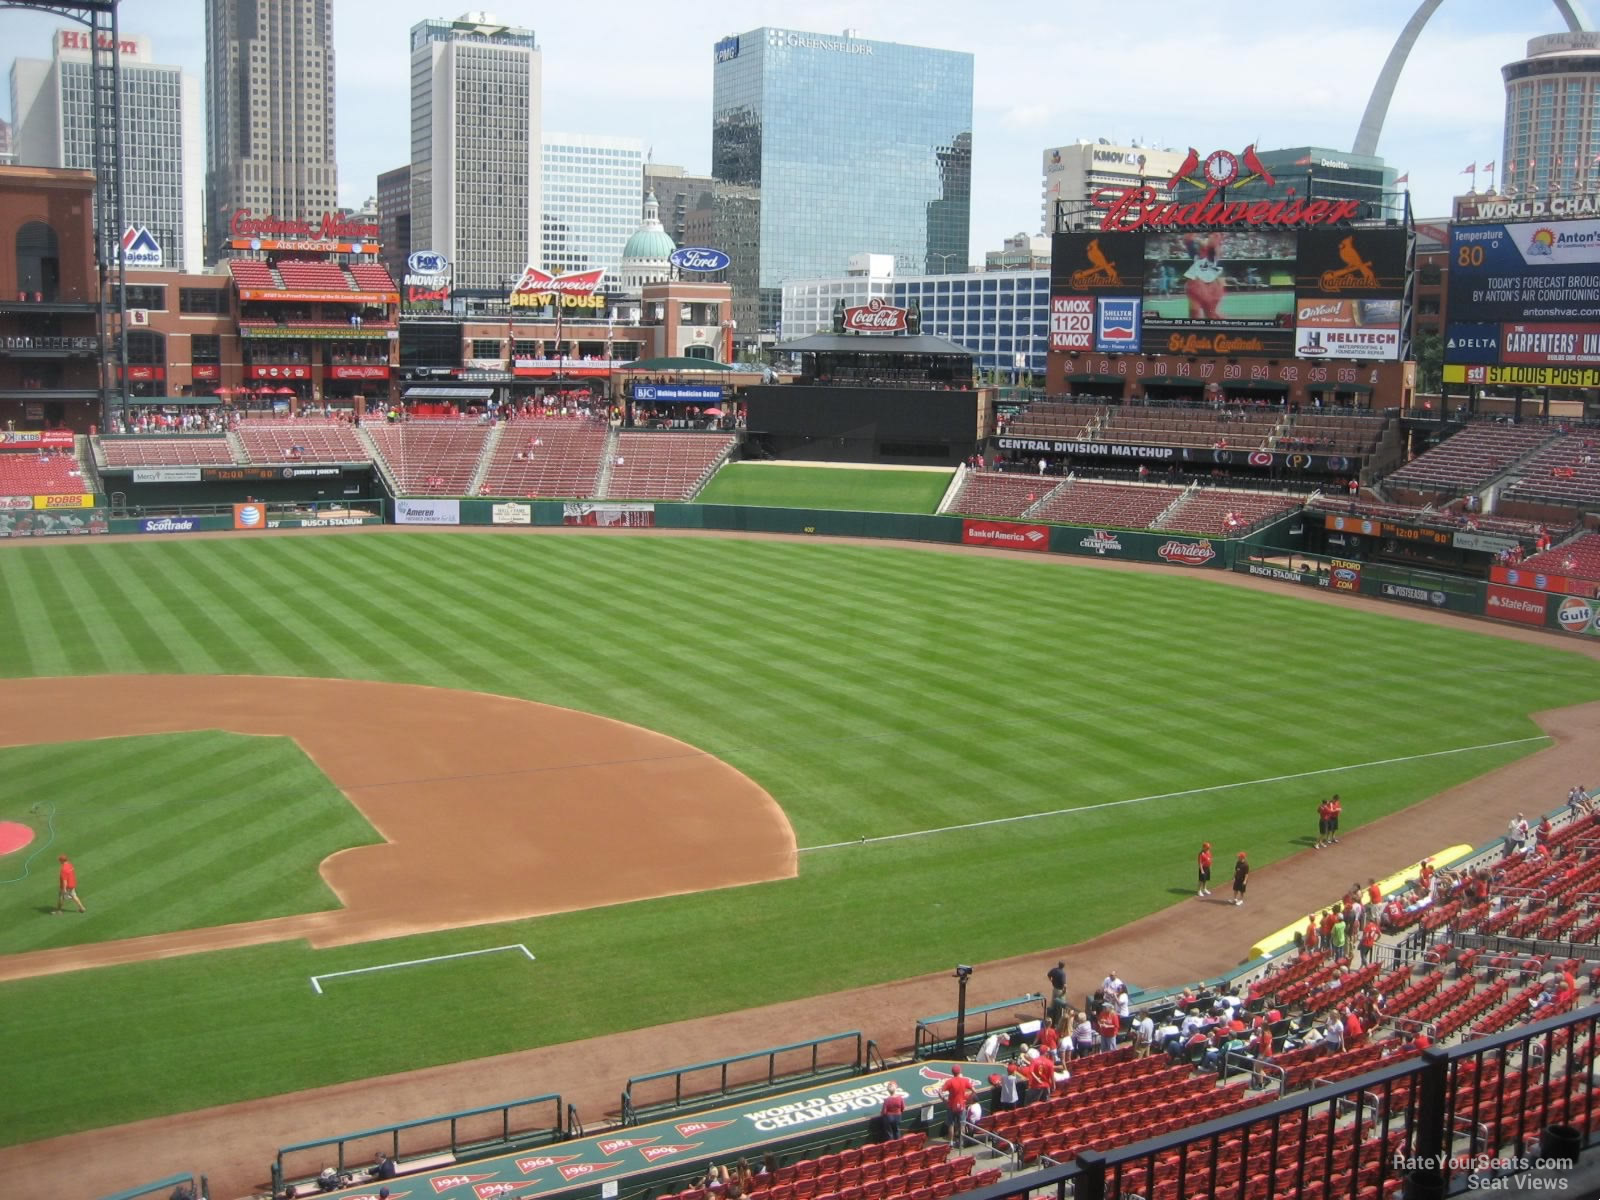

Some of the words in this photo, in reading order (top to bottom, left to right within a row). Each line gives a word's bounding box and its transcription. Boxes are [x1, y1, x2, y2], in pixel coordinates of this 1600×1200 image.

[62, 30, 137, 54] Hiton
[716, 46, 735, 62] KPMG
[1093, 149, 1124, 163] KMOV
[1091, 186, 1358, 232] Budweiser
[1476, 201, 1545, 218] WORLD
[231, 208, 310, 238] Cardinals
[310, 211, 380, 240] Nation
[1455, 230, 1503, 243] Temperature
[1557, 231, 1600, 244] Anton's
[276, 241, 296, 250] AT&T
[297, 241, 338, 251] ROOFTOP
[122, 251, 160, 264] ajestic
[417, 255, 439, 265] FOX
[682, 251, 719, 268] Ford
[1458, 245, 1485, 267] 80
[404, 274, 451, 286] MIDWEST
[510, 274, 607, 290] Budweiser
[1488, 277, 1520, 289] TODAY'S
[1523, 276, 1566, 288] FORECAST
[1568, 275, 1600, 288] BROUG
[510, 293, 552, 307] BREW
[555, 294, 605, 308] HOUSE
[1473, 290, 1483, 302] BY
[1485, 290, 1520, 301] ANTON'S
[1522, 290, 1535, 301] AIR
[1538, 289, 1599, 301] CONDITIONING
[1055, 300, 1090, 312] KMOX
[1523, 307, 1600, 316] antonshvac.com
[1055, 316, 1090, 331] 1120
[1053, 334, 1089, 347] KMOX
[1327, 332, 1396, 344] HELITECH
[1459, 338, 1496, 348] DELTA
[1507, 333, 1578, 354] CARPENTERS'
[1086, 360, 1091, 374] 1
[1100, 361, 1109, 374] 2
[1118, 361, 1127, 374] 6
[1136, 362, 1145, 375] 9
[1154, 362, 1167, 376] 10
[1177, 362, 1190, 376] 14
[1200, 363, 1214, 378] 17
[1224, 364, 1241, 379] 20
[1251, 365, 1269, 379] 24
[1280, 366, 1298, 380] 42
[1308, 367, 1327, 382] 45
[1338, 368, 1356, 382] 85
[1467, 366, 1484, 379] stl
[1490, 366, 1507, 383] ST.
[1510, 366, 1547, 384] LOUIS
[637, 388, 654, 398] BJC
[657, 390, 677, 398] Making
[999, 438, 1050, 451] CENTRAL
[1054, 442, 1108, 454] DIVISION
[1111, 445, 1173, 458] MATCHUP
[137, 473, 156, 481] Mercy
[218, 471, 243, 479] 12:00
[47, 495, 82, 504] DOBBS
[406, 508, 434, 517] Ameren
[146, 519, 193, 532] Scottrade
[301, 519, 327, 528] BUSCH
[329, 518, 363, 527] STADIUM
[968, 528, 986, 539] Bank
[987, 530, 995, 539] of
[995, 531, 1025, 542] America
[1396, 528, 1419, 539] 12:00
[1434, 533, 1446, 543] 80
[1080, 540, 1122, 550] CHAMPIONS
[1455, 537, 1474, 547] Mercy
[1331, 559, 1361, 571] STLFORD
[1250, 565, 1272, 577] BUSCH
[1273, 568, 1301, 582] STADIUM
[1395, 586, 1428, 601] POSTSEASON
[1500, 597, 1521, 610] State
[1522, 601, 1543, 614] Farm
[1560, 609, 1589, 621] Gulf
[744, 1098, 826, 1121] WORLD
[754, 1087, 910, 1131] CHAMPIONS
[681, 1121, 708, 1133] 2011
[603, 1138, 633, 1151] 1982
[645, 1145, 678, 1156] 2006
[522, 1156, 554, 1169] 1964
[564, 1163, 594, 1175] 1967
[436, 1175, 470, 1188] 1944
[480, 1183, 514, 1195] 1946
